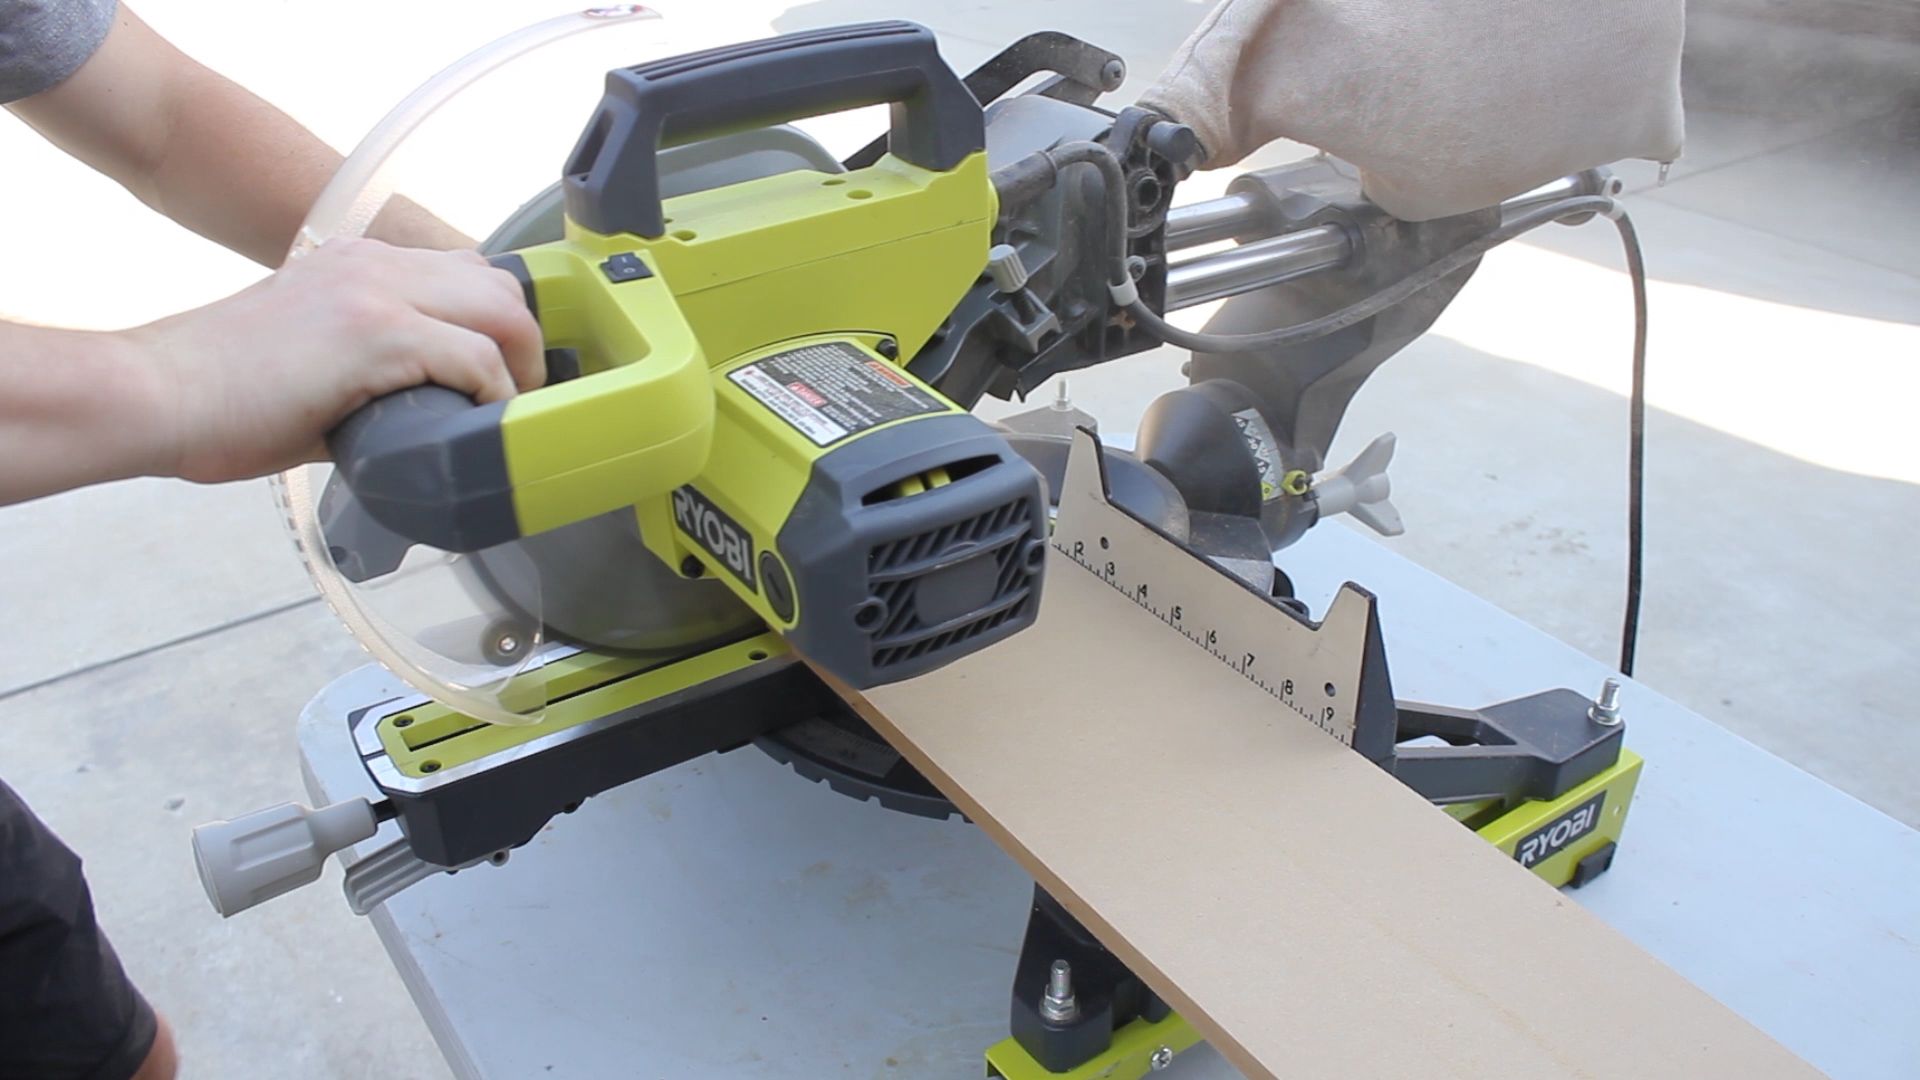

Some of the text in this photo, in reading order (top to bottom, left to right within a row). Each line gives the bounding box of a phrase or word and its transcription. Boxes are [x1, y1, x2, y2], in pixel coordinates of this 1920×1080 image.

[1247, 438, 1259, 450] 30
[673, 486, 753, 581] RYOBI
[1076, 541, 1335, 721] 2 3 4 5 6 7 8 9
[1520, 803, 1596, 866] RYOBI
